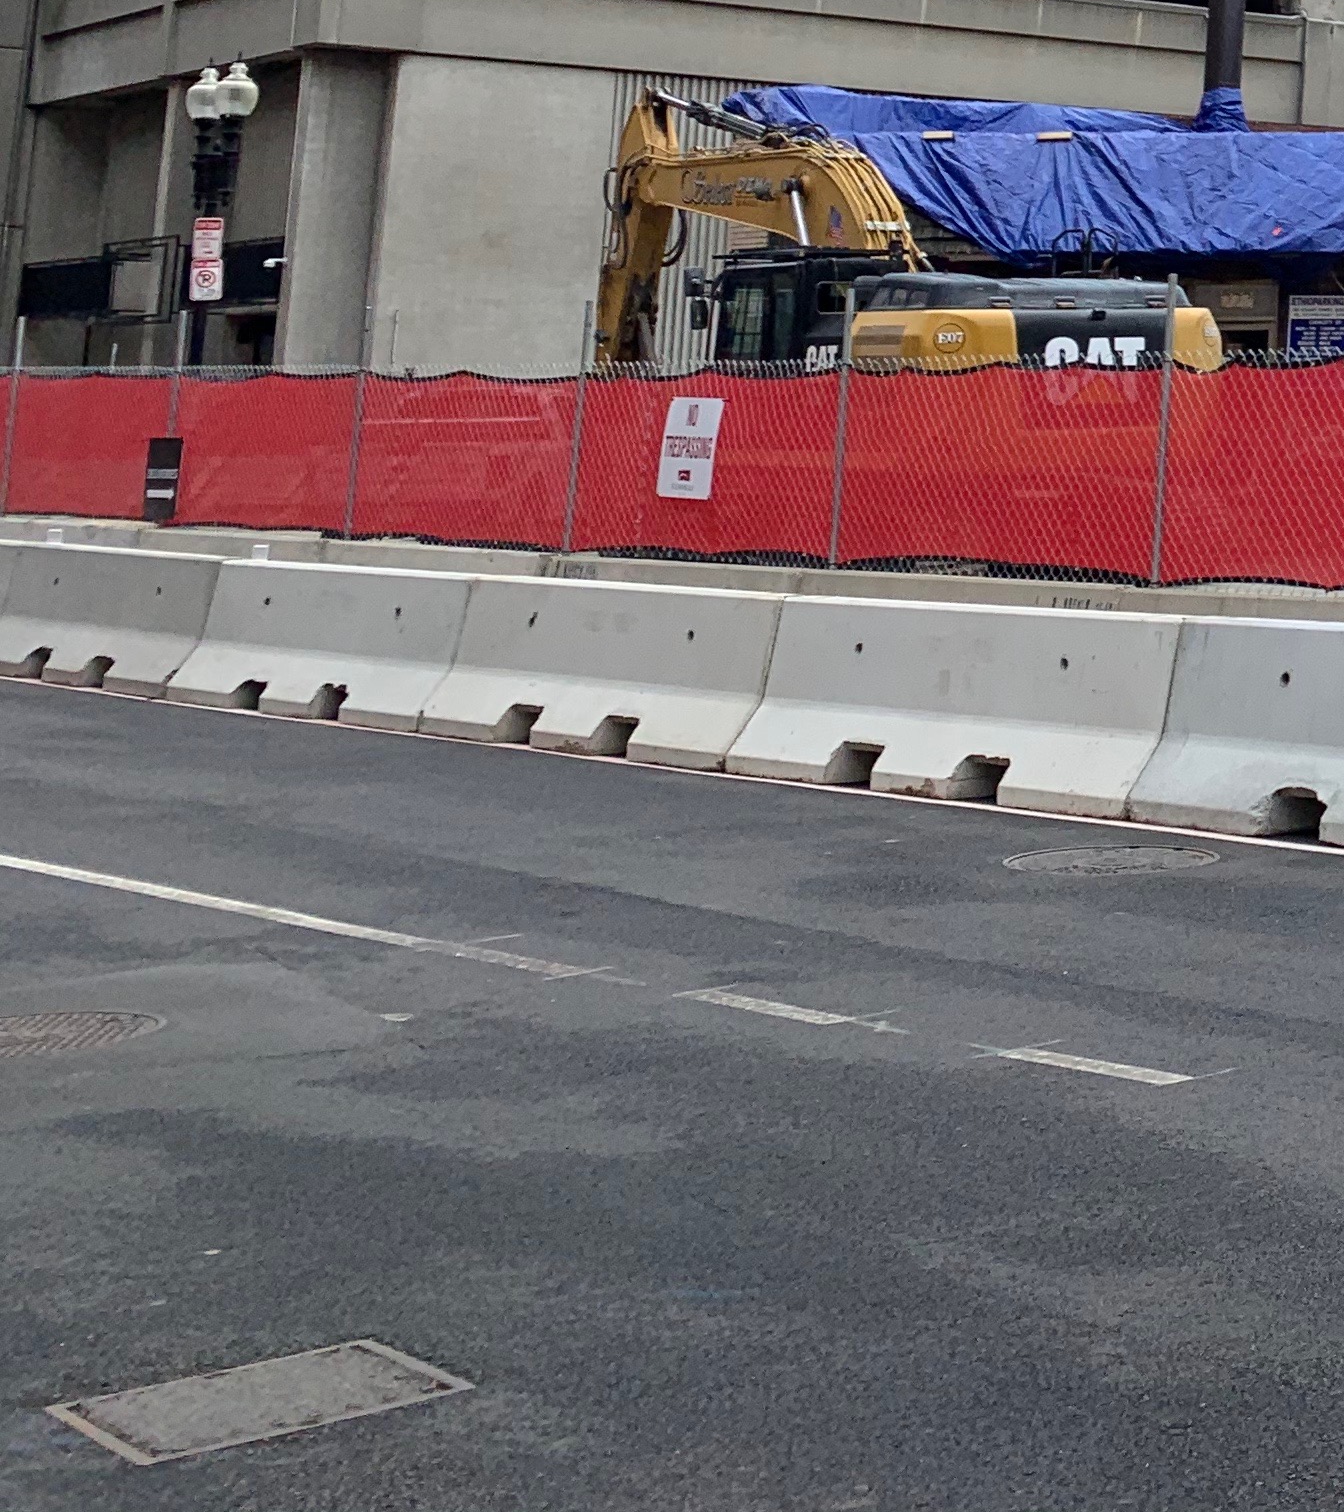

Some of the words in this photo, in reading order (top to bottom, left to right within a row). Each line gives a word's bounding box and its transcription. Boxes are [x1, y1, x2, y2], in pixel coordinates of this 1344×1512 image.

[806, 345, 839, 372] CAT
[1044, 336, 1147, 392] CAT
[685, 404, 699, 426] NO
[664, 435, 713, 459] TRESPASSING
